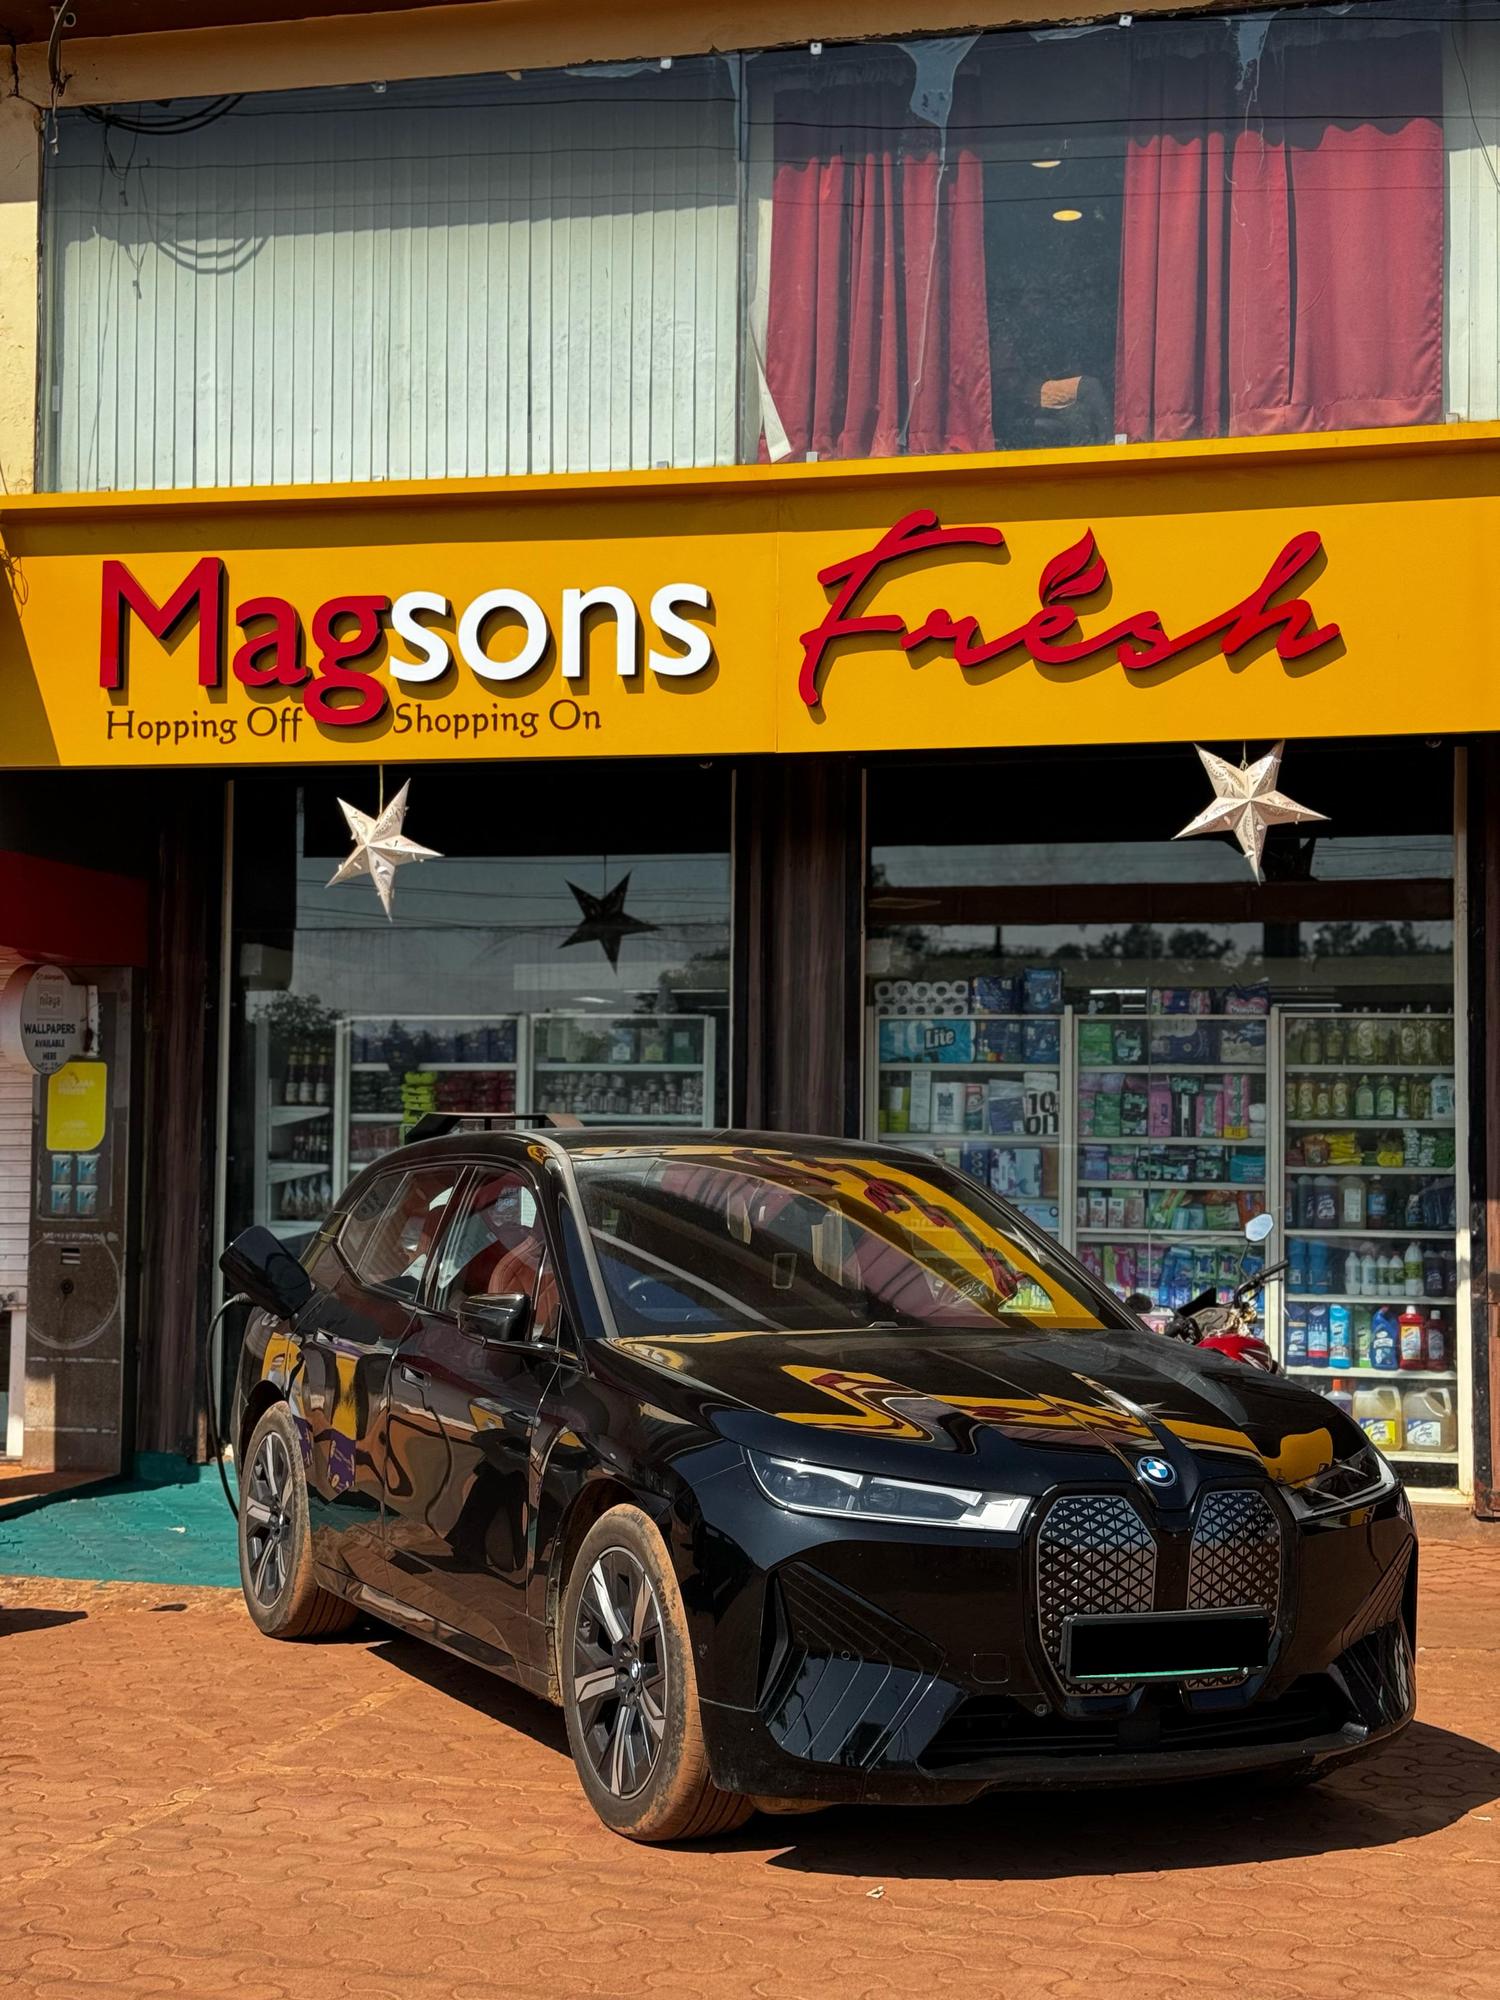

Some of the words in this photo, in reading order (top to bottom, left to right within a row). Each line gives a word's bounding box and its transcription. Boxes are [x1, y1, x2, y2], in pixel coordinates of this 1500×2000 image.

[100, 557, 713, 726] Magsons
[799, 509, 1342, 706] Fresh
[106, 709, 238, 744] Hopping
[247, 705, 304, 743] Off
[392, 702, 540, 739] Shopping
[548, 700, 602, 732] On
[24, 1023, 76, 1034] WALLPAPERS
[34, 1039, 65, 1048] AVAILABLE
[925, 1029, 955, 1049] Lite
